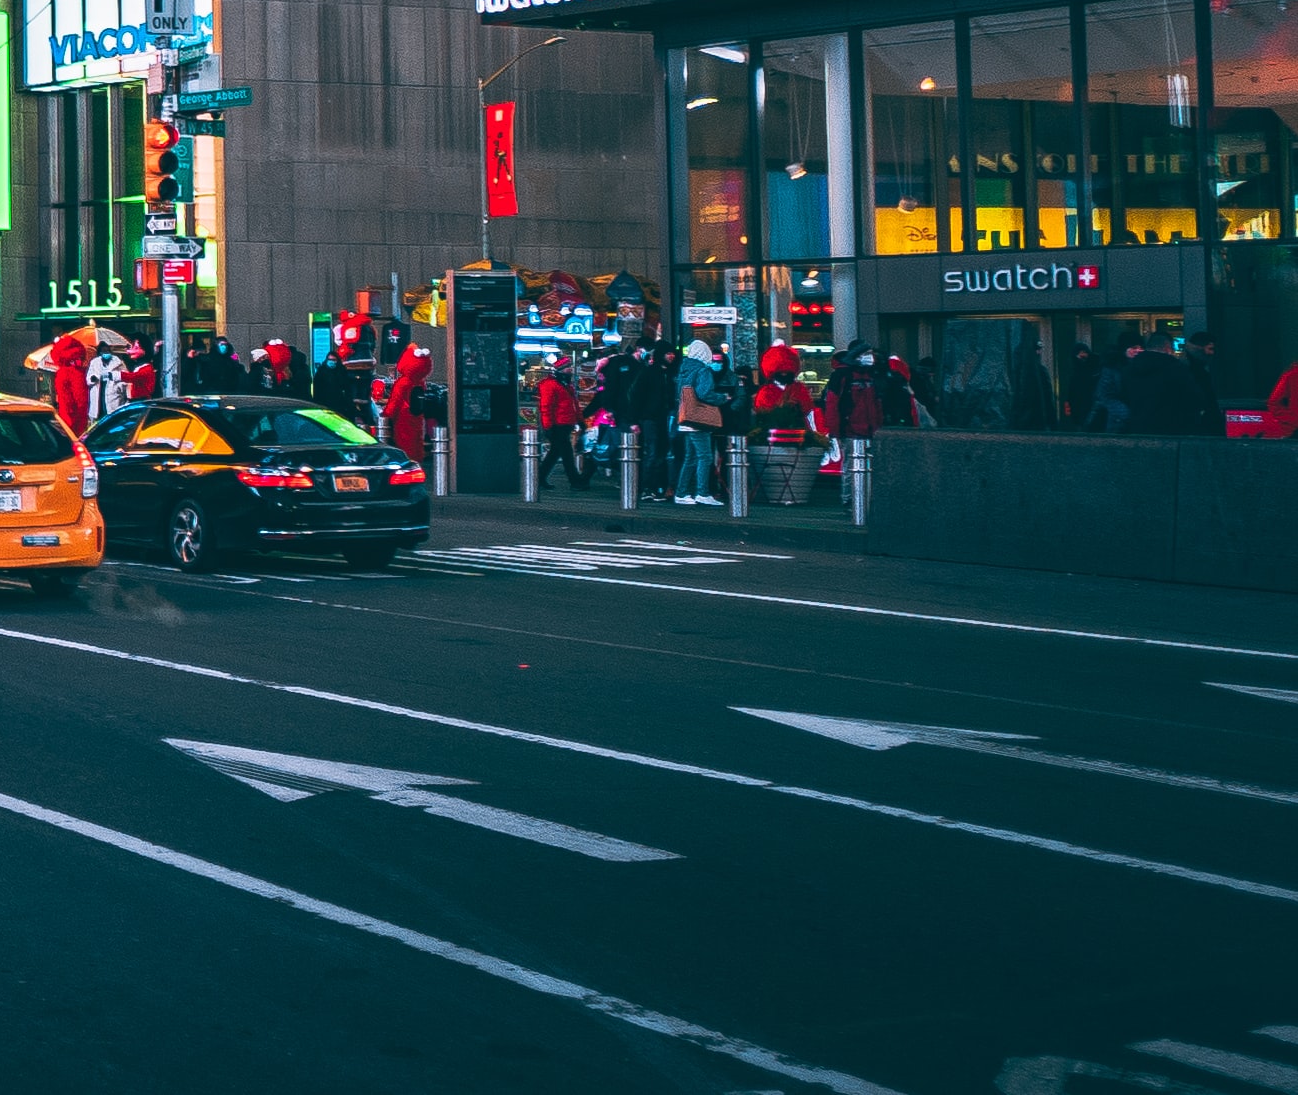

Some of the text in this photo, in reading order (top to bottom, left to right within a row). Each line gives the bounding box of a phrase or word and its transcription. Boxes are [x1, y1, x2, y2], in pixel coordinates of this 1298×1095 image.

[153, 16, 188, 29] ONLY
[179, 95, 213, 107] George
[215, 90, 248, 102] Abbott
[200, 123, 213, 134] 45
[178, 242, 197, 253] WAY
[944, 262, 1073, 292] swatch
[49, 278, 123, 309] 1515
